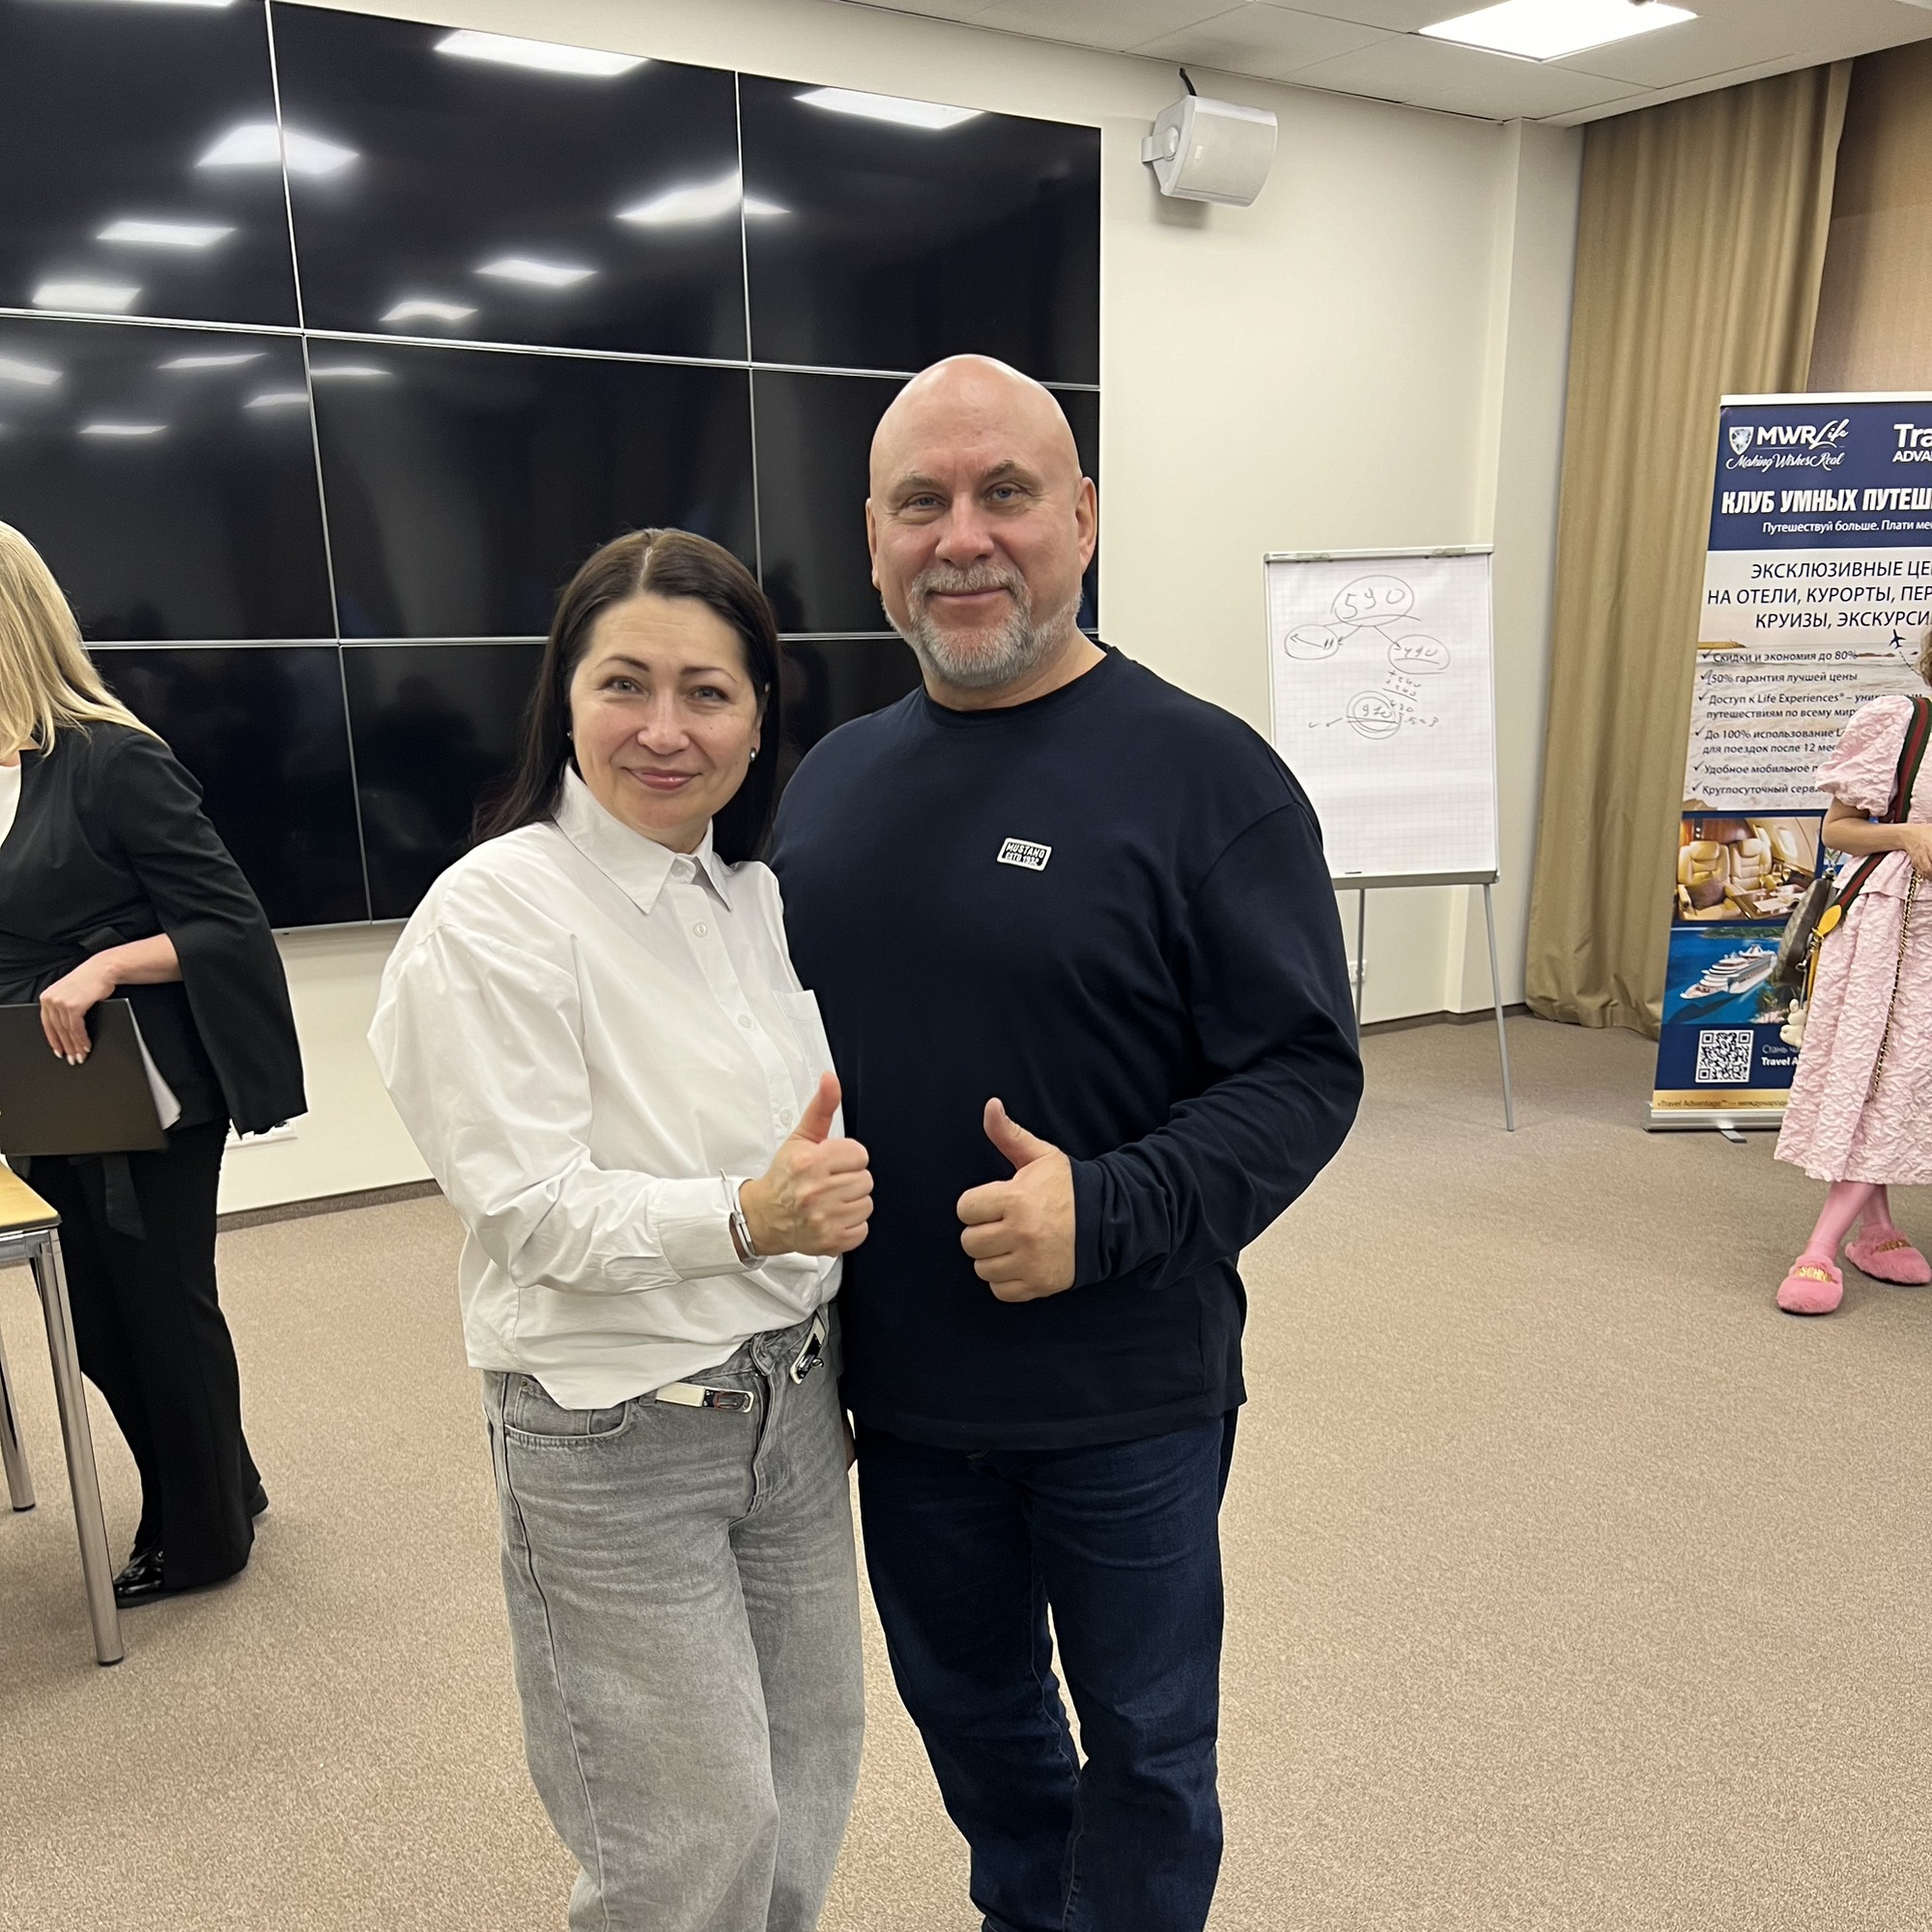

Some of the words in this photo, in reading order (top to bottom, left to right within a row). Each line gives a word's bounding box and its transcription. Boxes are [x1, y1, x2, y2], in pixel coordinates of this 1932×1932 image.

[1757, 425, 1816, 445] MWR
[1808, 418, 1850, 450] Life
[1725, 453, 1773, 472] Making
[1773, 453, 1810, 468] Wishes
[1810, 452, 1845, 470] Real
[1892, 450, 1932, 463] ADVA
[1721, 491, 1776, 514] КЛУБ
[1779, 489, 1859, 513] УМНЫХ
[1861, 487, 1932, 511] ПУТЕШ
[1762, 521, 1833, 535] Путешествуй
[1834, 520, 1880, 531] больше.
[1881, 519, 1914, 530] Плати
[1750, 560, 1903, 580] ЭКСКЛЮЗИВНЫЕ
[1907, 560, 1932, 580] ЦЕ
[1707, 589, 1732, 605] НА
[1736, 587, 1802, 606] ОТЕЛИ,
[1806, 585, 1895, 604] КУРОРТЫ,
[1900, 585, 1932, 601] ПЕР
[1755, 611, 1832, 630] КРУИЗЫ,
[1836, 611, 1932, 627] ЭКСКУРСИ
[1713, 652, 1754, 664] Скидки
[1754, 654, 1762, 663] и
[1763, 652, 1816, 663] экономия
[1818, 652, 1832, 662] до
[1834, 650, 1857, 661] 80%
[1736, 674, 1785, 684] гарантия
[1787, 672, 1827, 683] лучшей
[1830, 673, 1858, 682] цены
[1708, 695, 1747, 706] Доступ
[1757, 693, 1776, 703] Life
[1706, 710, 1783, 721] путешествиям
[1801, 709, 1833, 719] всему
[1834, 709, 1857, 719] мир
[1705, 729, 1719, 741] До
[1722, 729, 1751, 739] 100%
[1753, 729, 1833, 739] использование
[1702, 746, 1721, 754] для
[1724, 745, 1769, 753] поездок
[1804, 743, 1816, 752] 12
[1704, 764, 1749, 775] Удобное
[1751, 763, 1809, 773] мобильное
[1702, 784, 1788, 796] Круглосуточный
[1761, 1057, 1791, 1065] Travel
